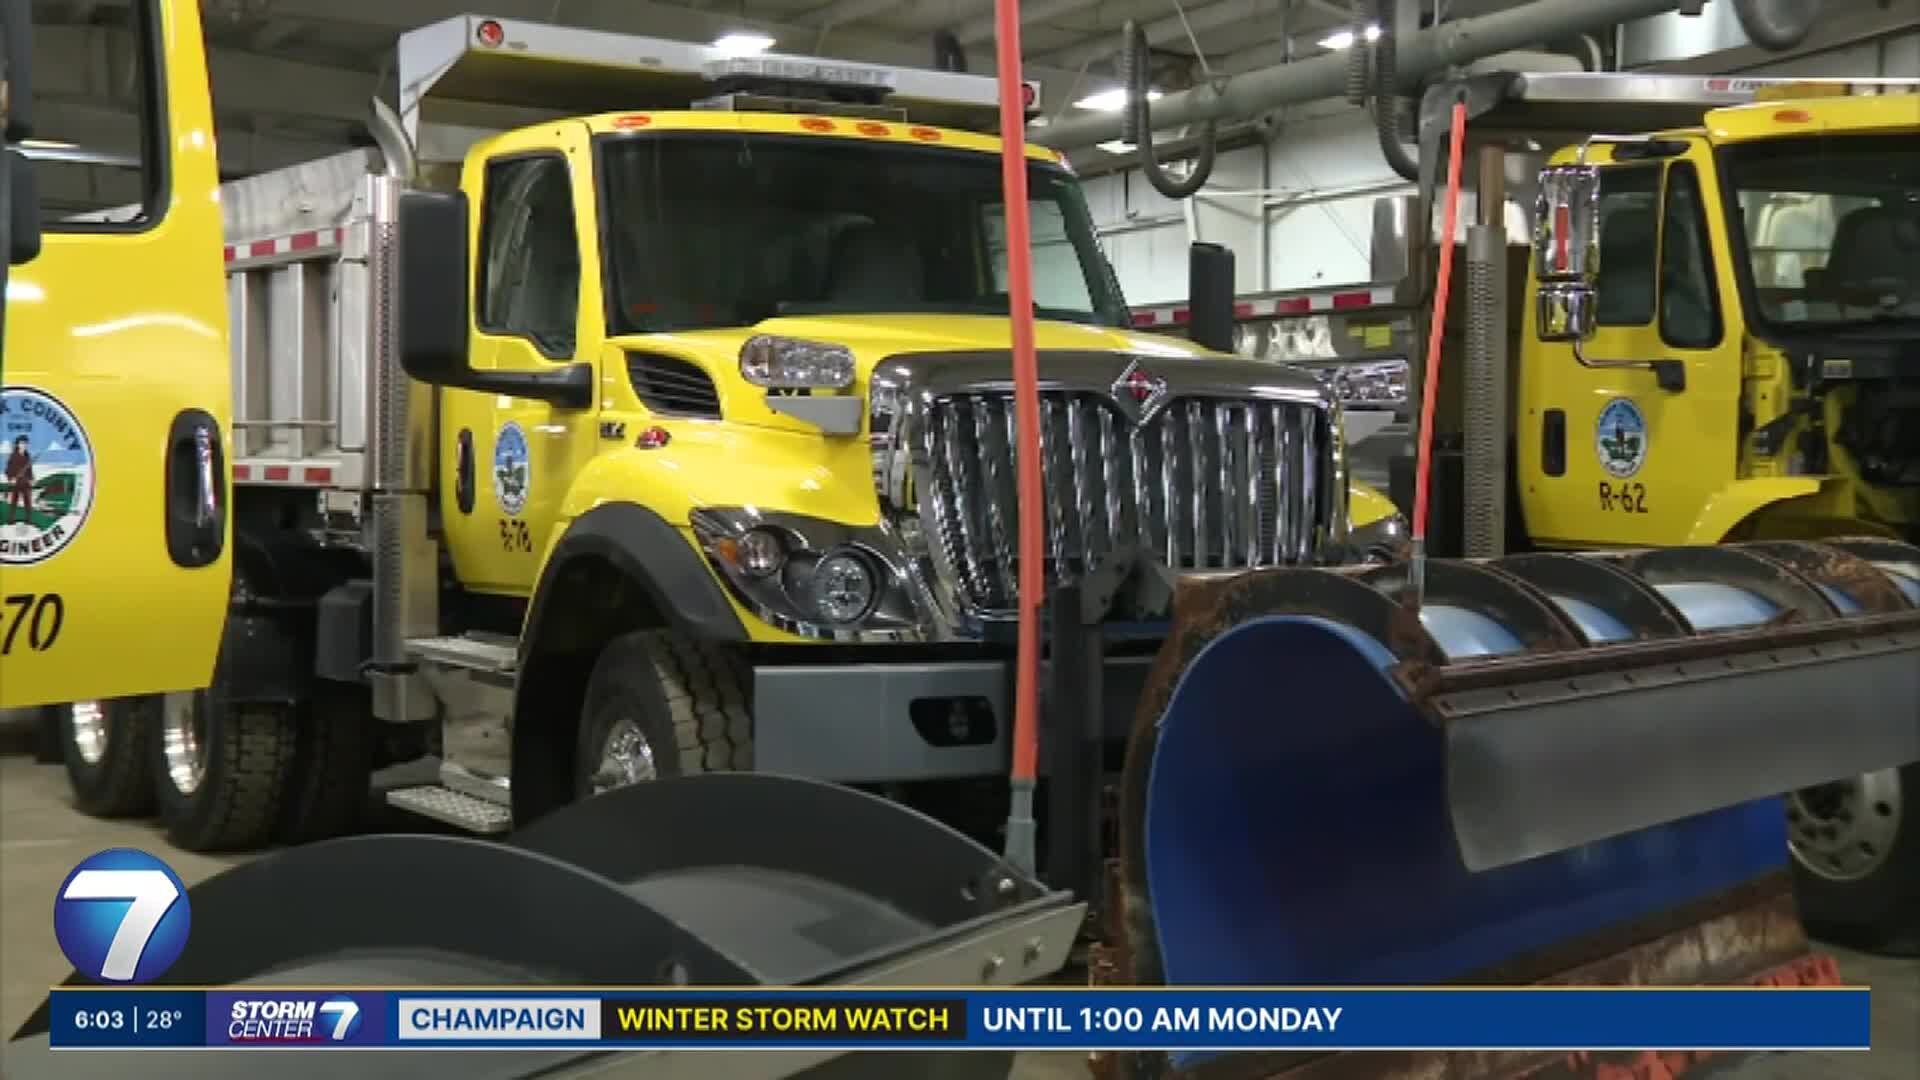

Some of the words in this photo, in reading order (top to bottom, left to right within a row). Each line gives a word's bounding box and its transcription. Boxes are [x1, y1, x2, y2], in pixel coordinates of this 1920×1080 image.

[20, 398, 81, 451] COUNTY
[1599, 482, 1648, 513] R-62
[0, 525, 64, 555] GINEER
[0, 593, 64, 655] 70
